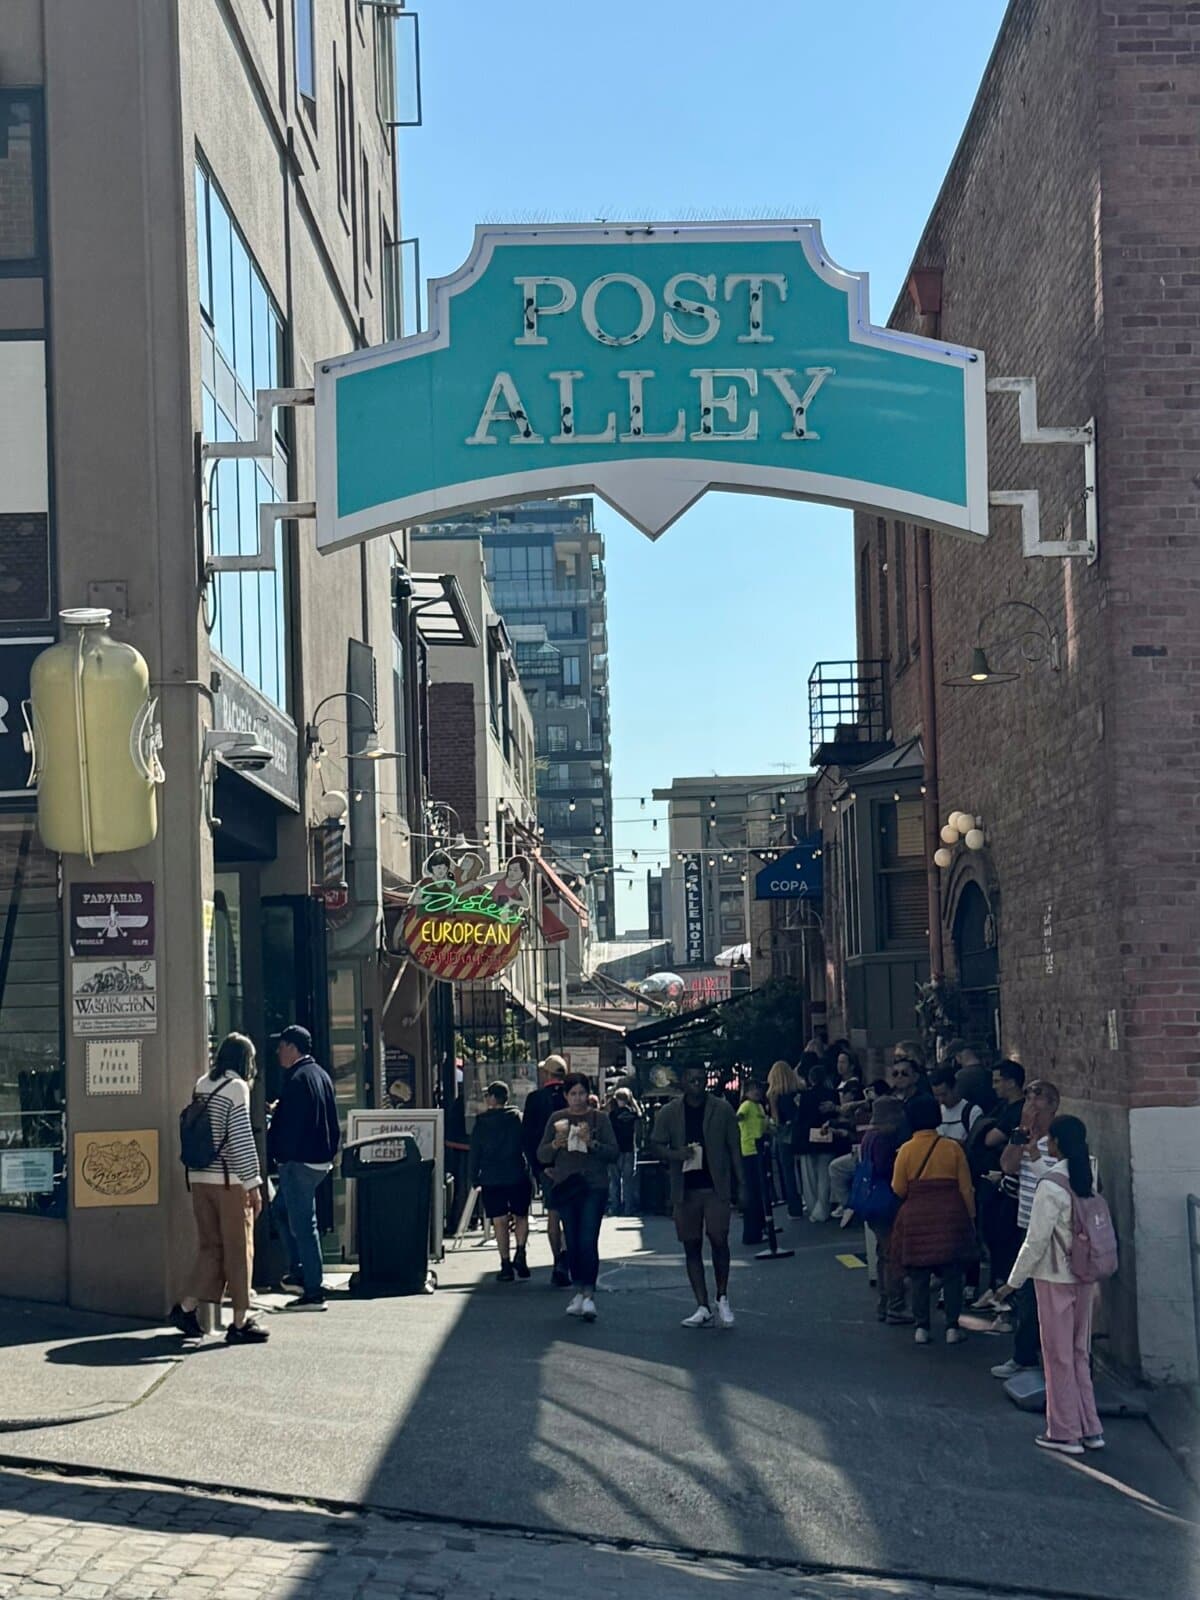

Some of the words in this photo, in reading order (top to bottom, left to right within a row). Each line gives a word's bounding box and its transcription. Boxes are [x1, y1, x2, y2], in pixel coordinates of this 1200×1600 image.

[513, 273, 788, 346] POST
[465, 366, 836, 445] ALLEY
[686, 853, 698, 870] LA
[770, 880, 808, 891] COPA
[686, 875, 700, 918] SALLE
[421, 921, 511, 945] EUROPEAN
[75, 996, 155, 1014] WASHINGTON
[103, 1048, 125, 1058] Pike
[375, 1147, 404, 1158] CENT
